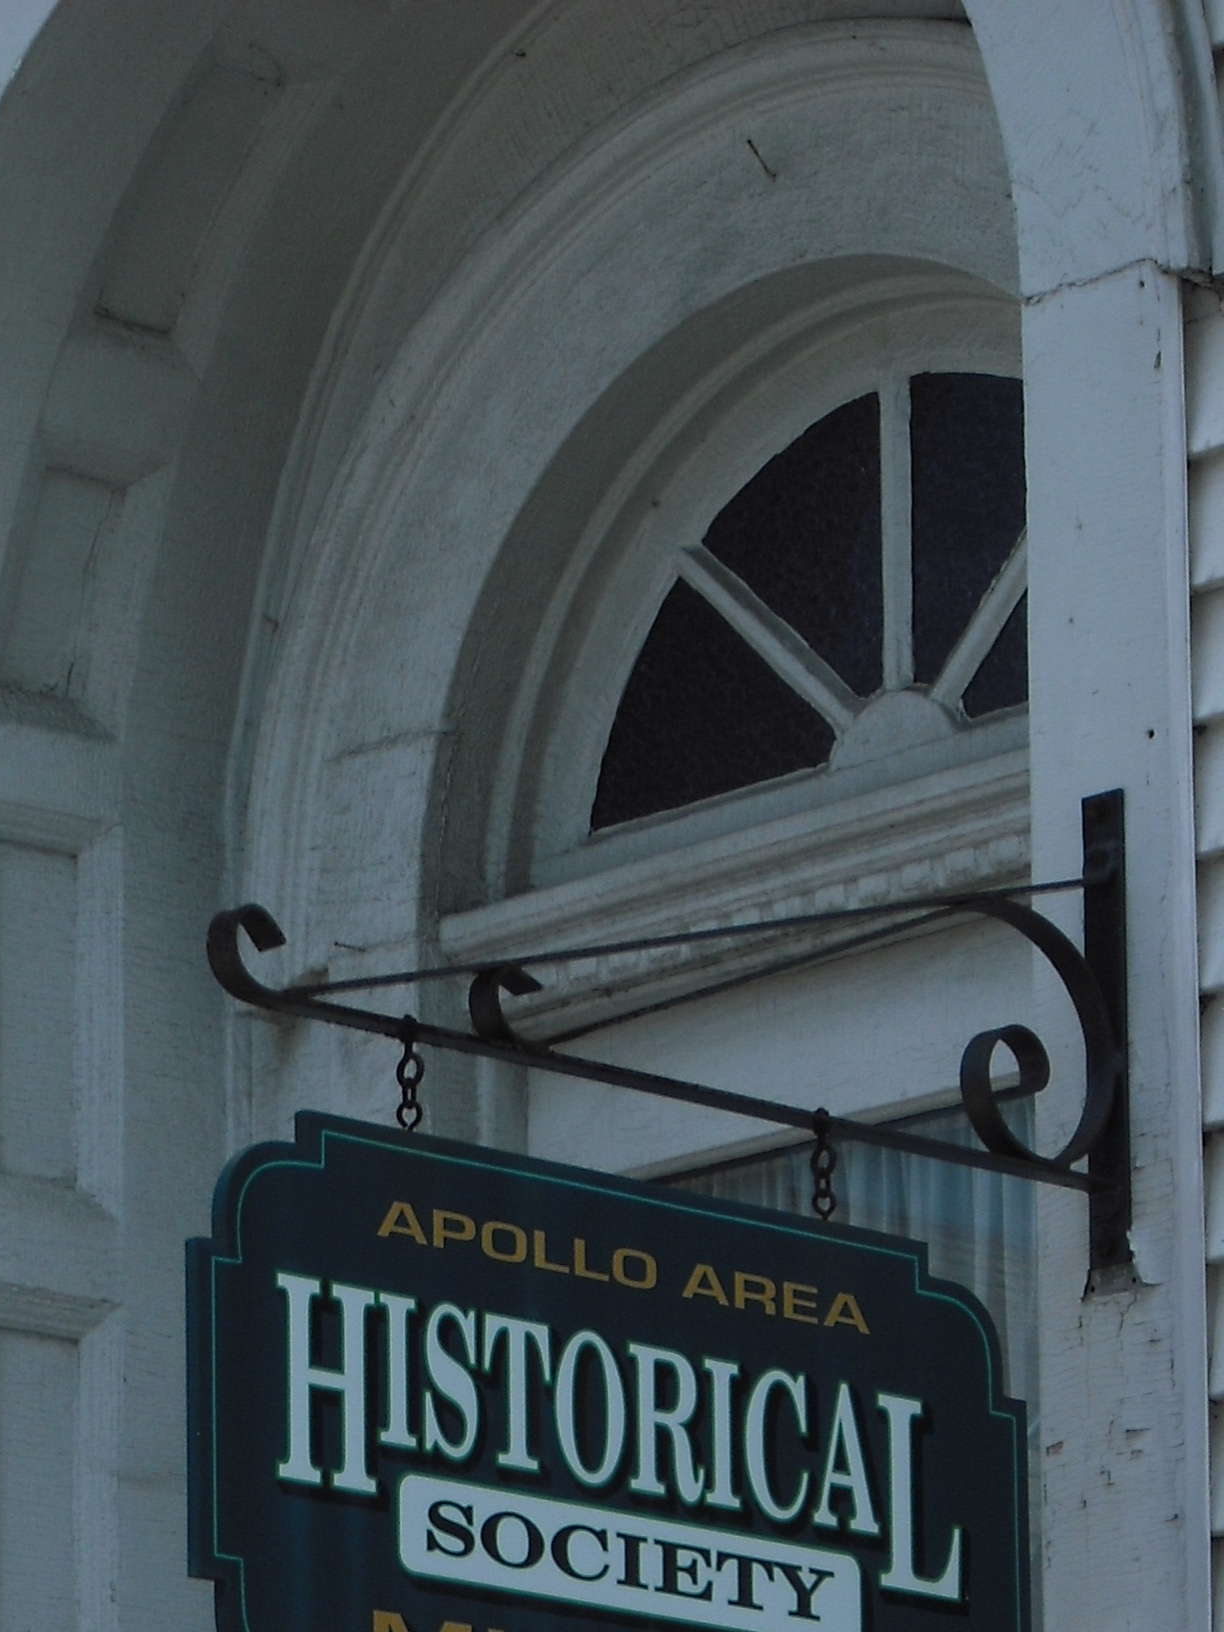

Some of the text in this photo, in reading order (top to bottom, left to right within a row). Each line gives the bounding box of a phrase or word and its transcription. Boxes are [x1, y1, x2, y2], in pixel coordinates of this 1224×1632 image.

[377, 1200, 872, 1336] APOLLO AREA
[275, 1272, 964, 1602] HISTORICAL
[426, 1500, 835, 1622] SOCIETY
